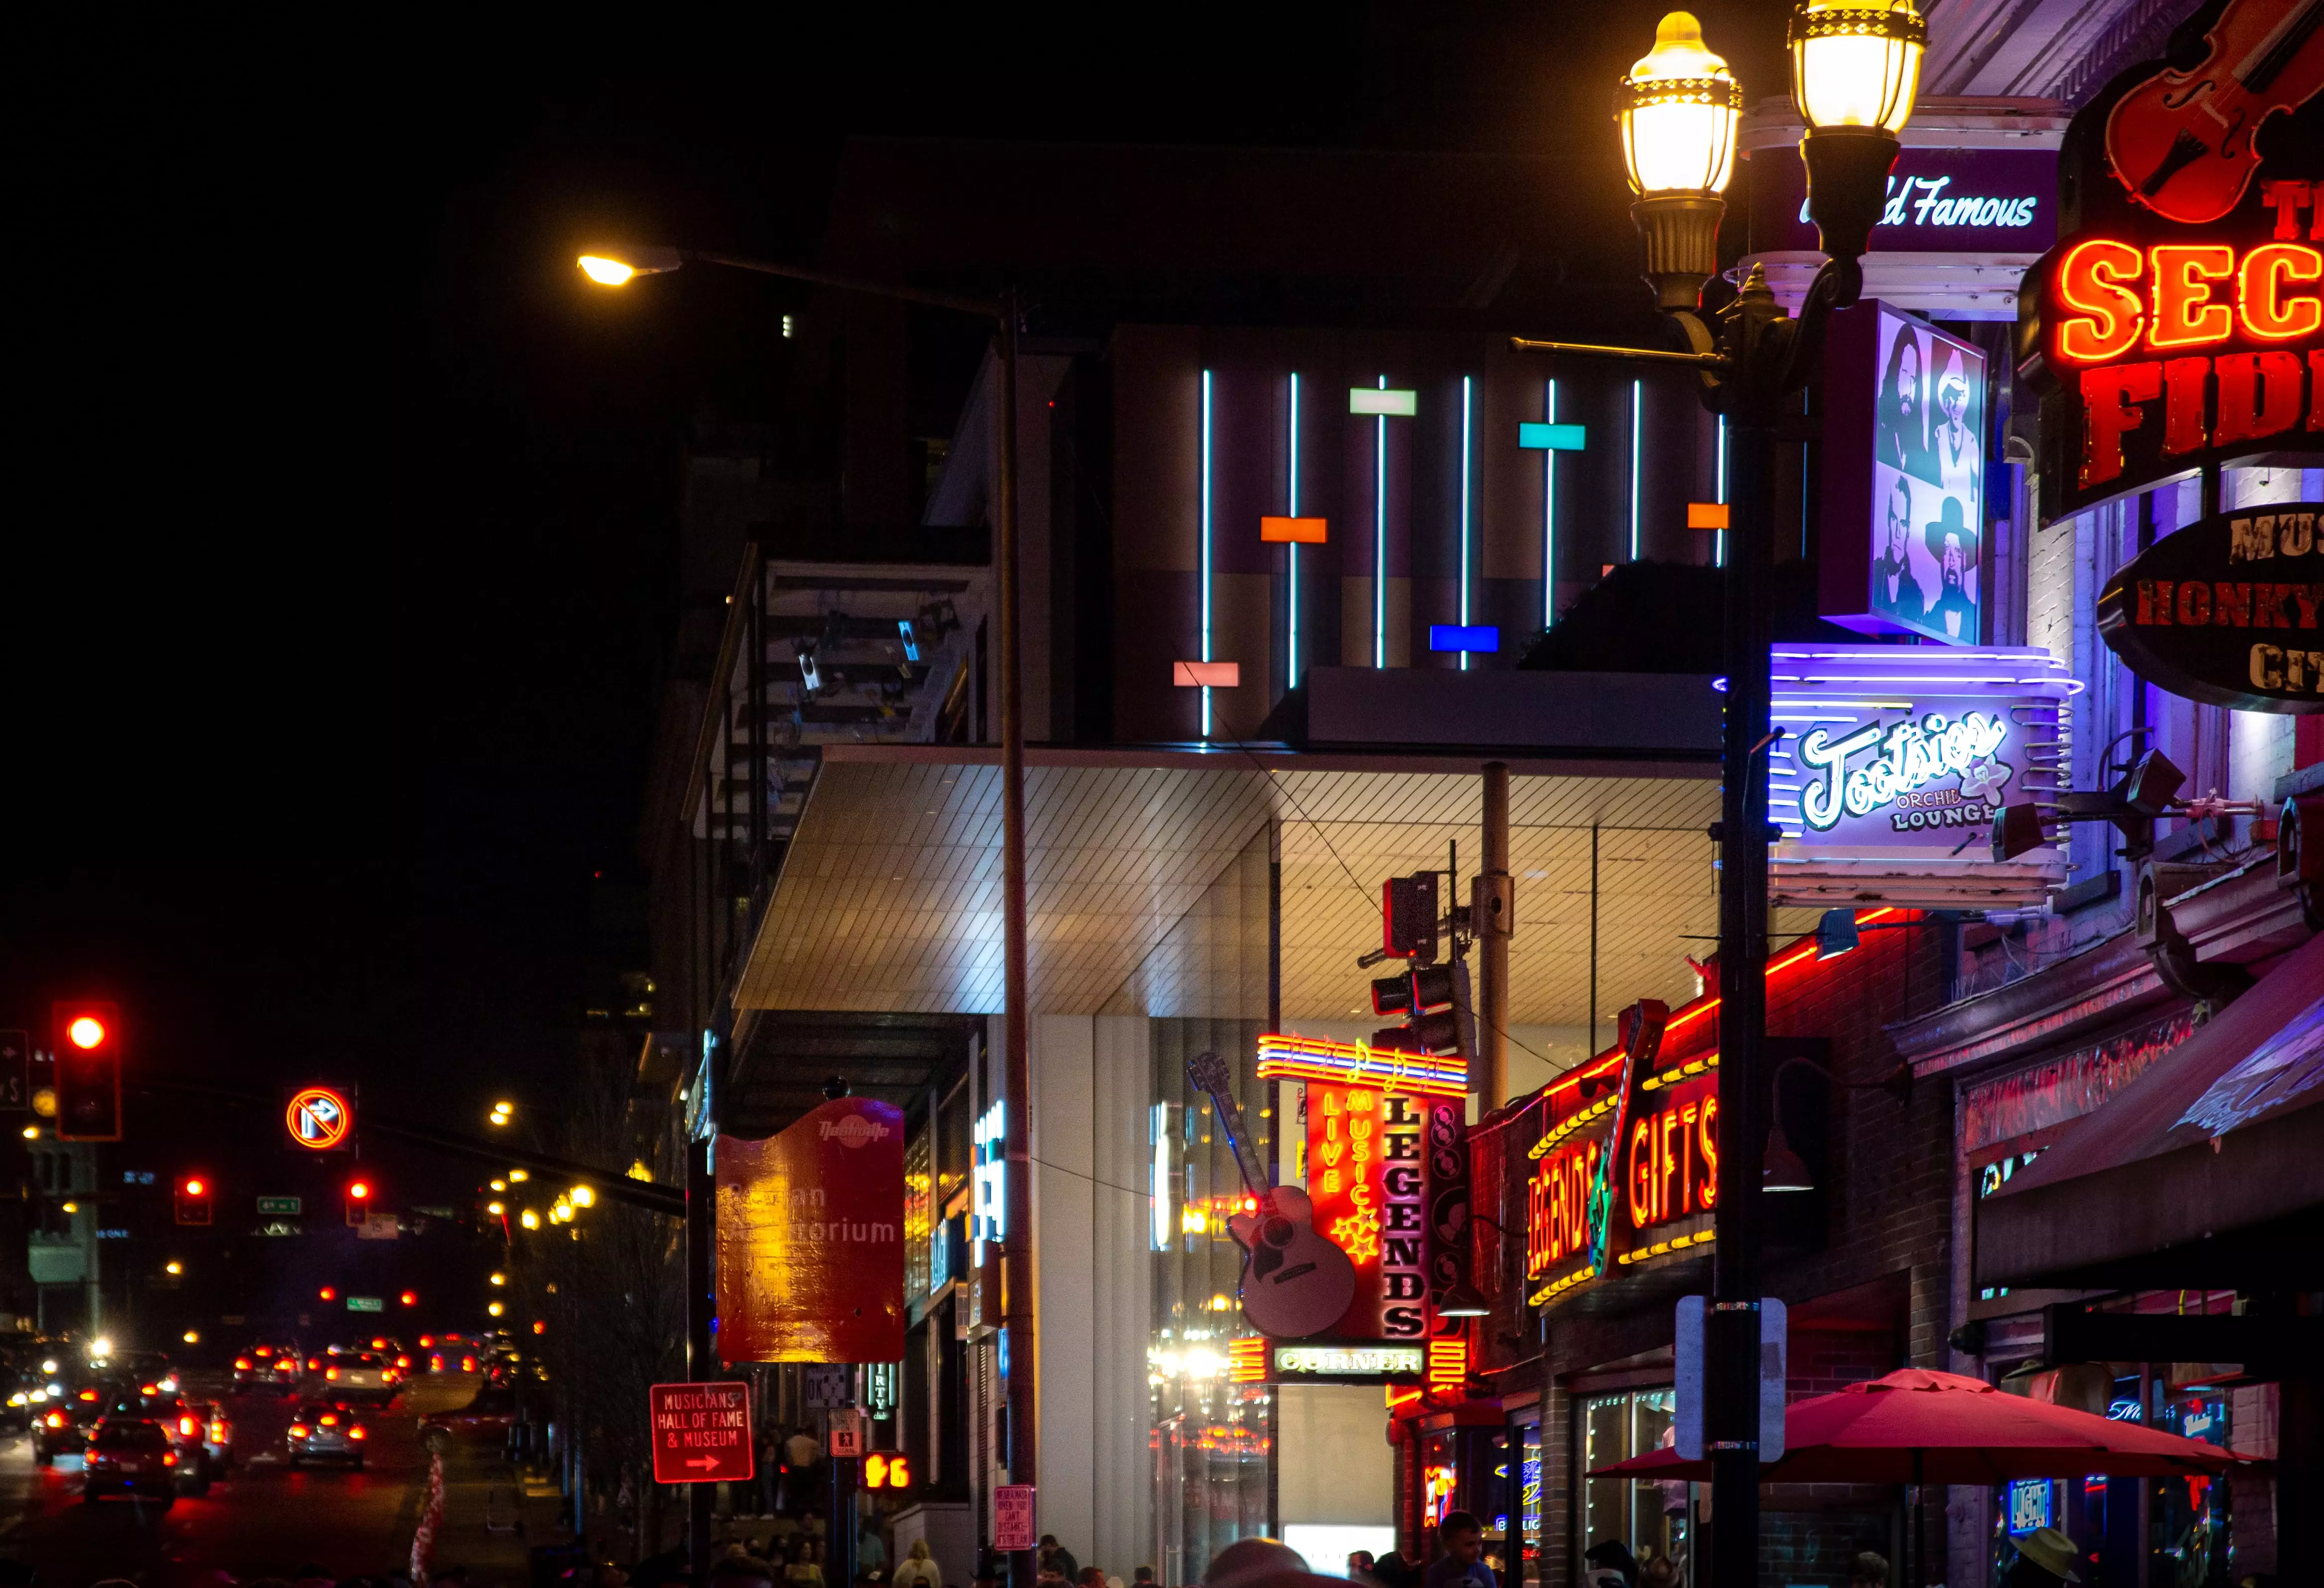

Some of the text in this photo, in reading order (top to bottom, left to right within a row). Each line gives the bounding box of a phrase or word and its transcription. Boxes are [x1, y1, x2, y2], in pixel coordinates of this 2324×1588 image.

[1915, 175, 2037, 228] Famous
[2260, 180, 2324, 241] T
[2055, 238, 2324, 363] SEC
[2078, 350, 2324, 491] FID
[2229, 513, 2324, 565] MU
[2135, 580, 2324, 629] HONKY
[1800, 711, 2007, 832] Tootsies
[1893, 804, 1996, 831] LOUNGE
[1896, 790, 1962, 810] ORCHID
[1321, 1092, 1342, 1194] LIVE
[1346, 1090, 1373, 1206] MUSIC
[1629, 1094, 1718, 1229] GIFTS
[1382, 1097, 1425, 1338] LEGENDS
[1279, 1352, 1420, 1371] CORNER
[657, 1411, 745, 1429] HALL OF FAME
[664, 1392, 736, 1411] MUSICIANS
[667, 1430, 738, 1448] & MUSEUM
[890, 1457, 909, 1488] 6
